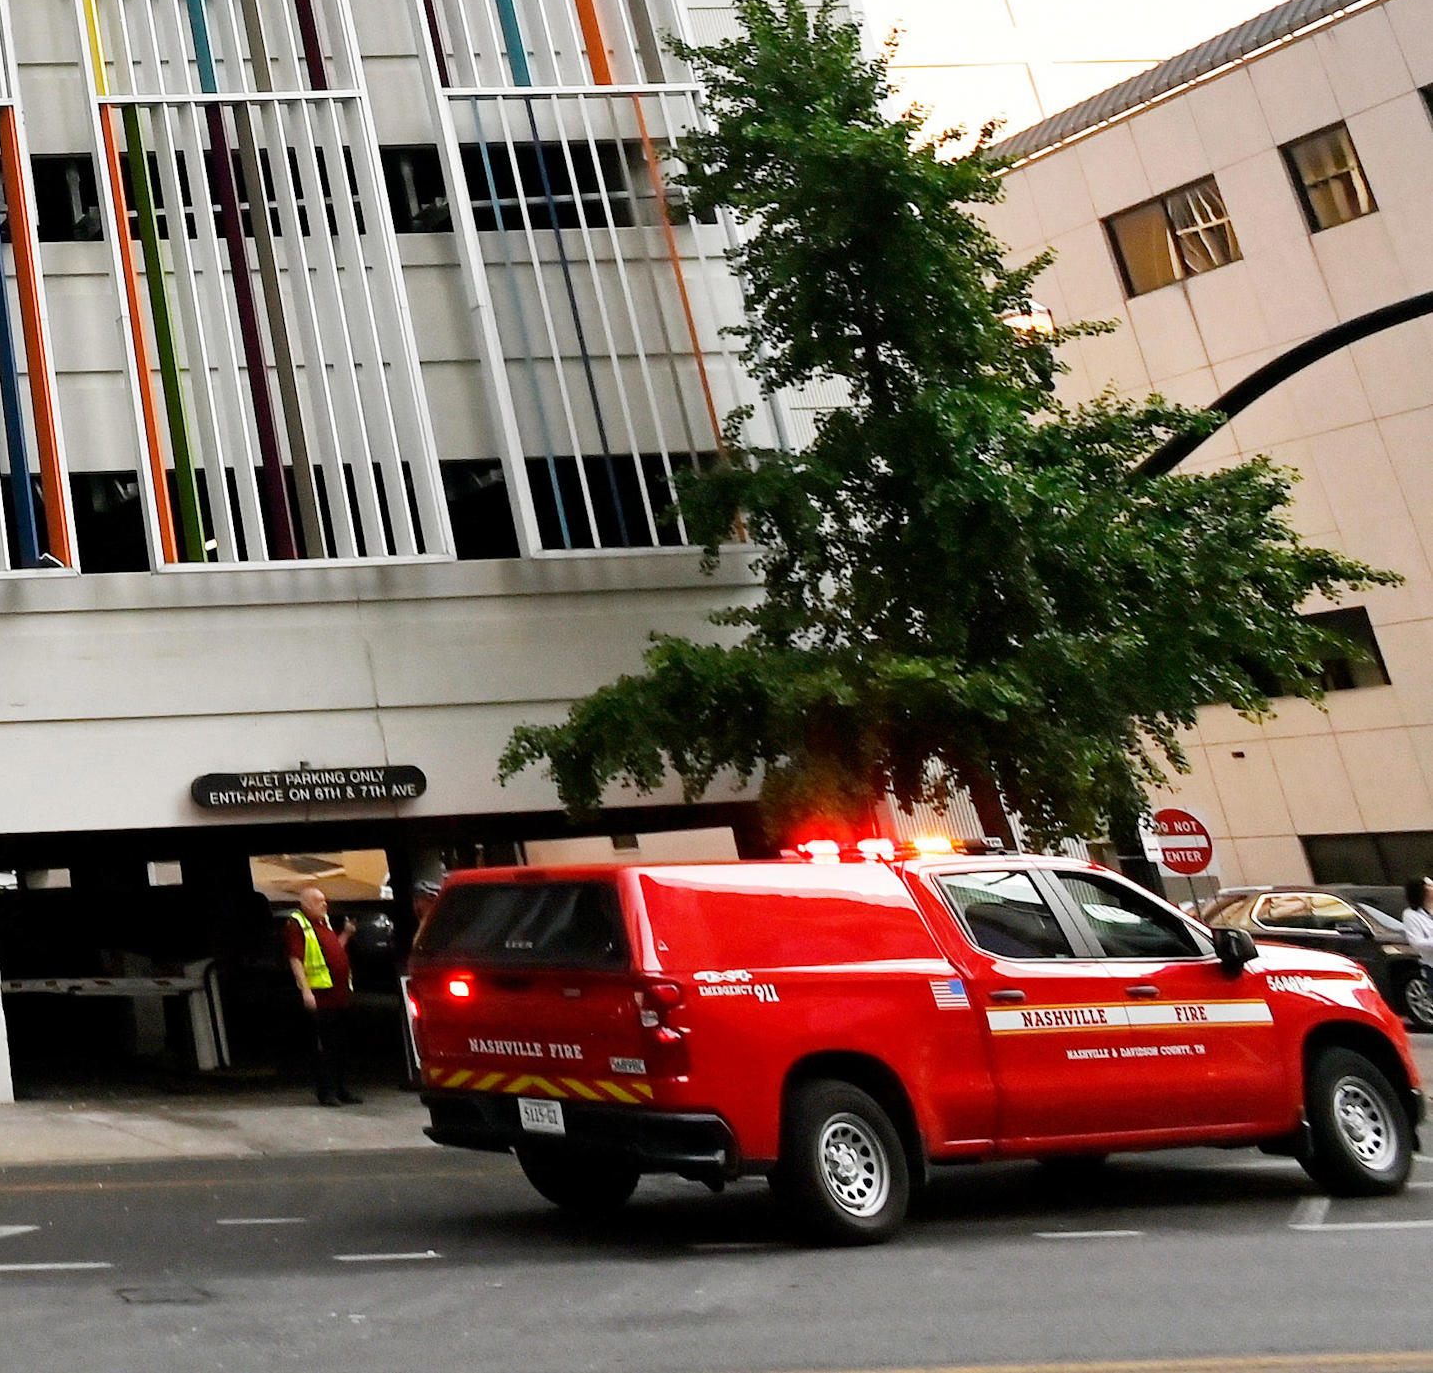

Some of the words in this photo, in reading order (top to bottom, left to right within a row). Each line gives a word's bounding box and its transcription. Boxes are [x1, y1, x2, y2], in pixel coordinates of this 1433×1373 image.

[239, 774, 279, 788] VALET
[285, 772, 345, 786] PARKING
[349, 770, 385, 784] ONLY
[210, 790, 284, 805] ENTRANCE
[288, 789, 309, 801] ON
[314, 788, 341, 800] 6TH
[346, 787, 355, 799] &
[360, 785, 386, 798] 7TH
[391, 784, 417, 796] AVE
[1173, 820, 1197, 832] NOT
[1165, 850, 1203, 863] ENTER
[698, 984, 753, 996] EMERGENCY
[754, 984, 780, 1003] 911
[1021, 1009, 1107, 1028] NASHVILLE
[1174, 1006, 1208, 1022] FIRE
[468, 1038, 543, 1057] NASHVILLE
[548, 1043, 583, 1059] FIRE
[1066, 1048, 1110, 1059] NASHVILLE
